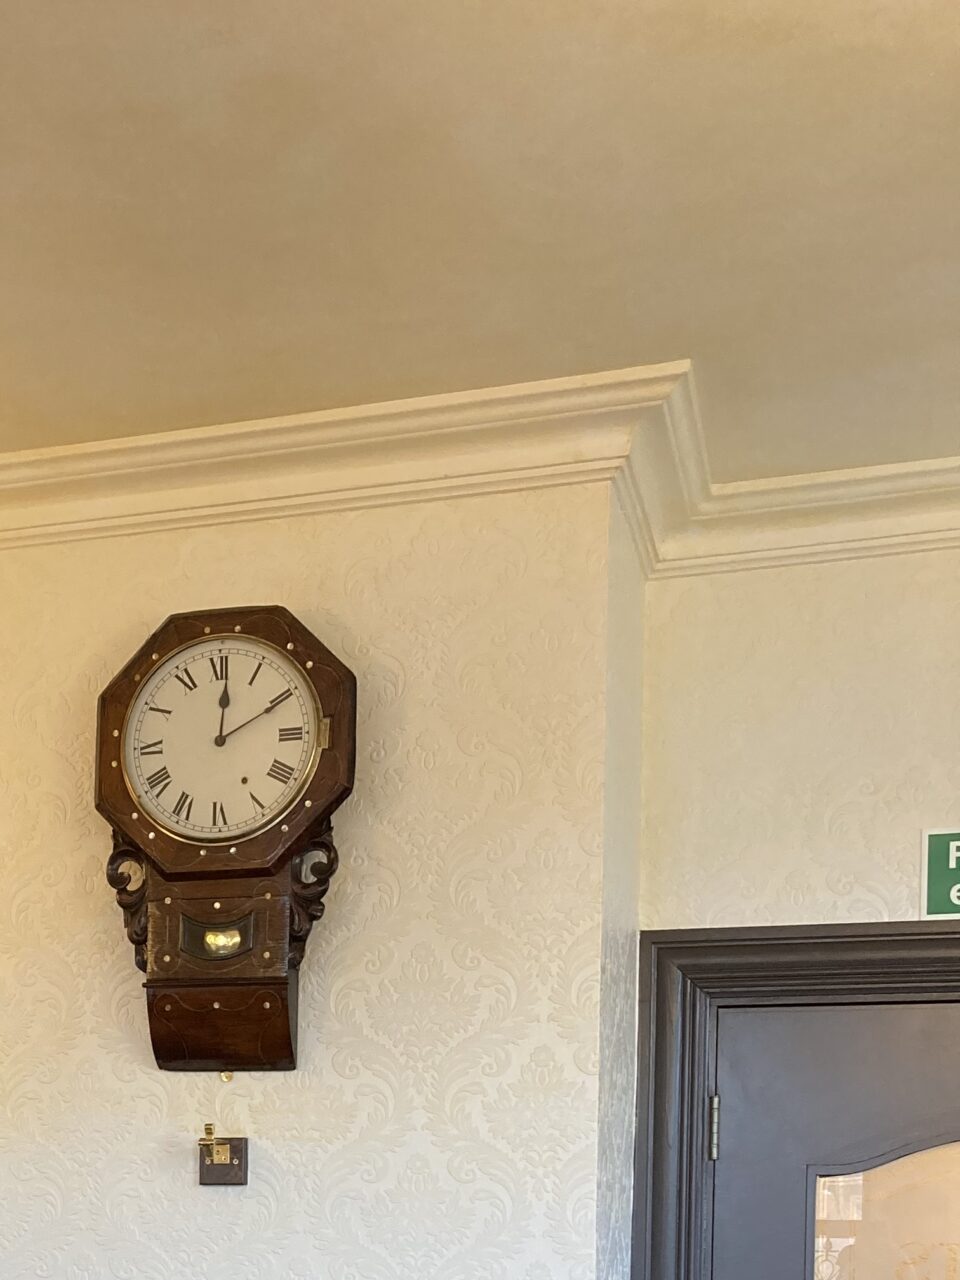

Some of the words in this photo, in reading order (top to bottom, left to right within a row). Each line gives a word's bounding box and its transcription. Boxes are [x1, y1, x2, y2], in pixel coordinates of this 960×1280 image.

[174, 667, 198, 696] XI
[209, 656, 228, 683] XII
[248, 662, 263, 686] I
[149, 700, 172, 721] X
[140, 739, 163, 756] IX
[278, 727, 303, 743] III
[146, 766, 172, 799] VIII
[266, 759, 295, 785] IIII
[172, 791, 193, 821] VII
[212, 802, 228, 827] VI
[249, 791, 265, 814] V
